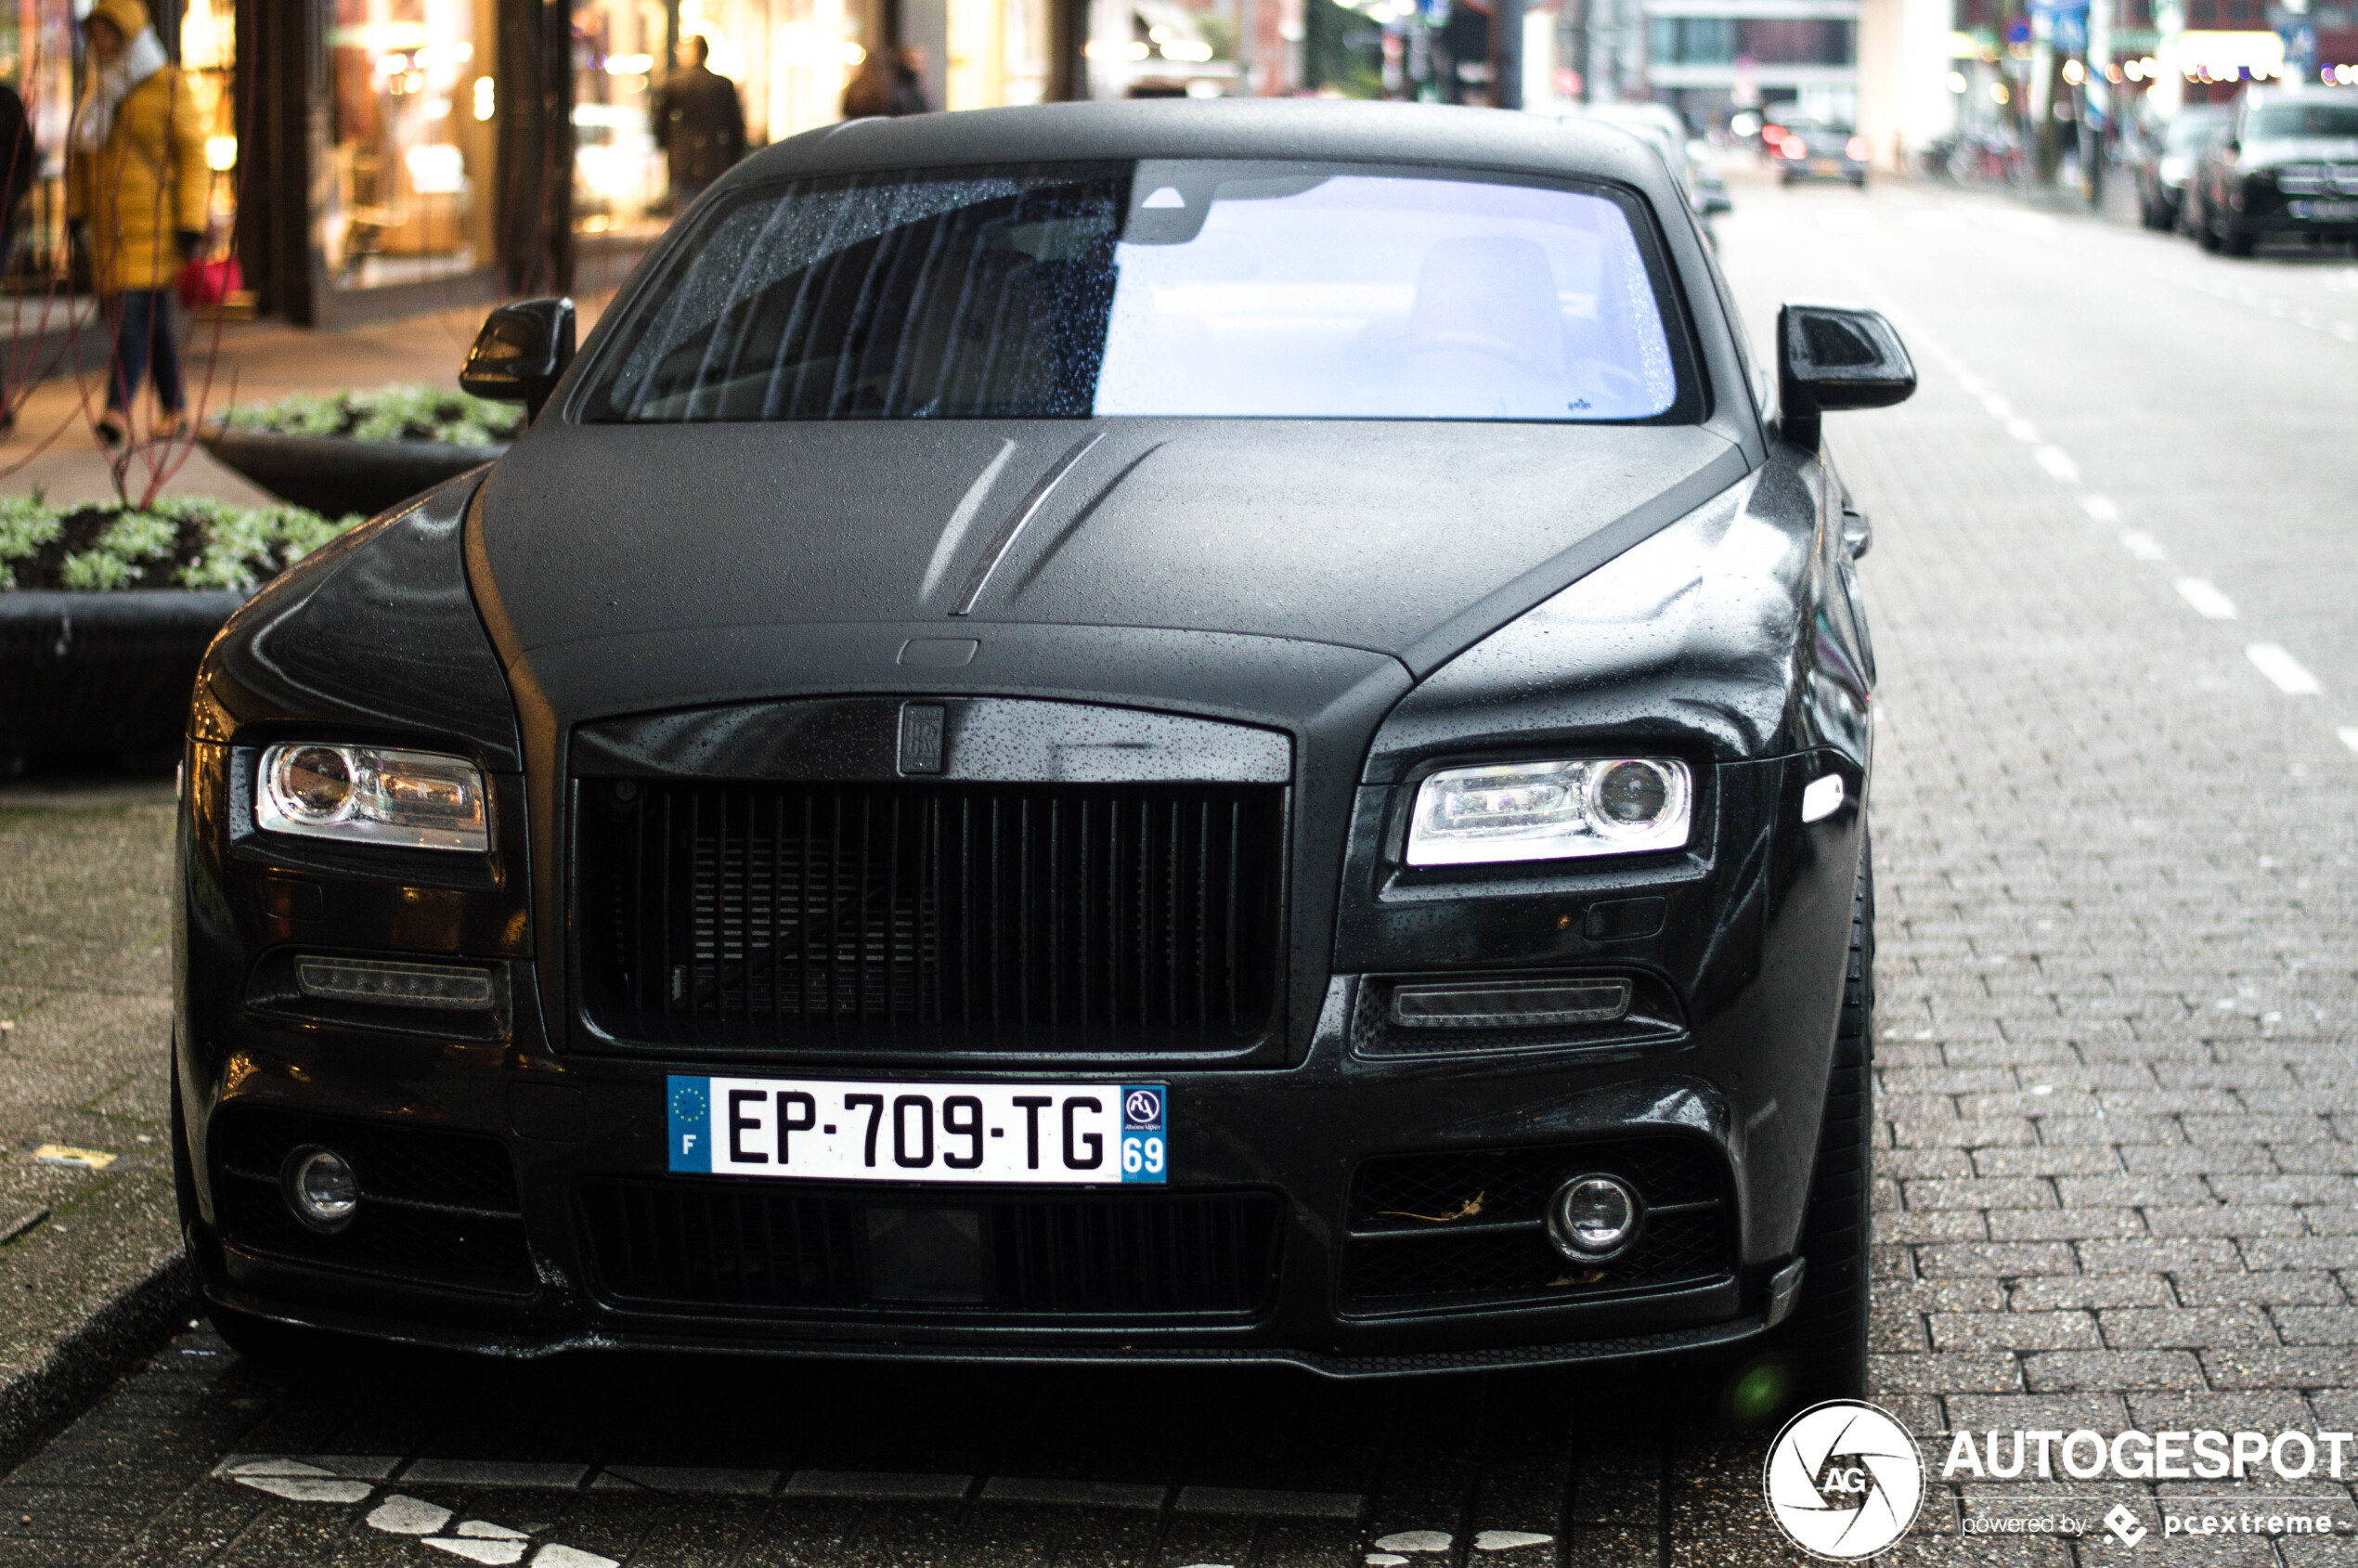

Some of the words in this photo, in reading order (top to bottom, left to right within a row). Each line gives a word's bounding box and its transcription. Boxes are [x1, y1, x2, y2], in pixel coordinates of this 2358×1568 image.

[682, 1134, 696, 1155] F
[729, 1089, 1103, 1170] EP-709-TG
[1123, 1137, 1164, 1173] 69
